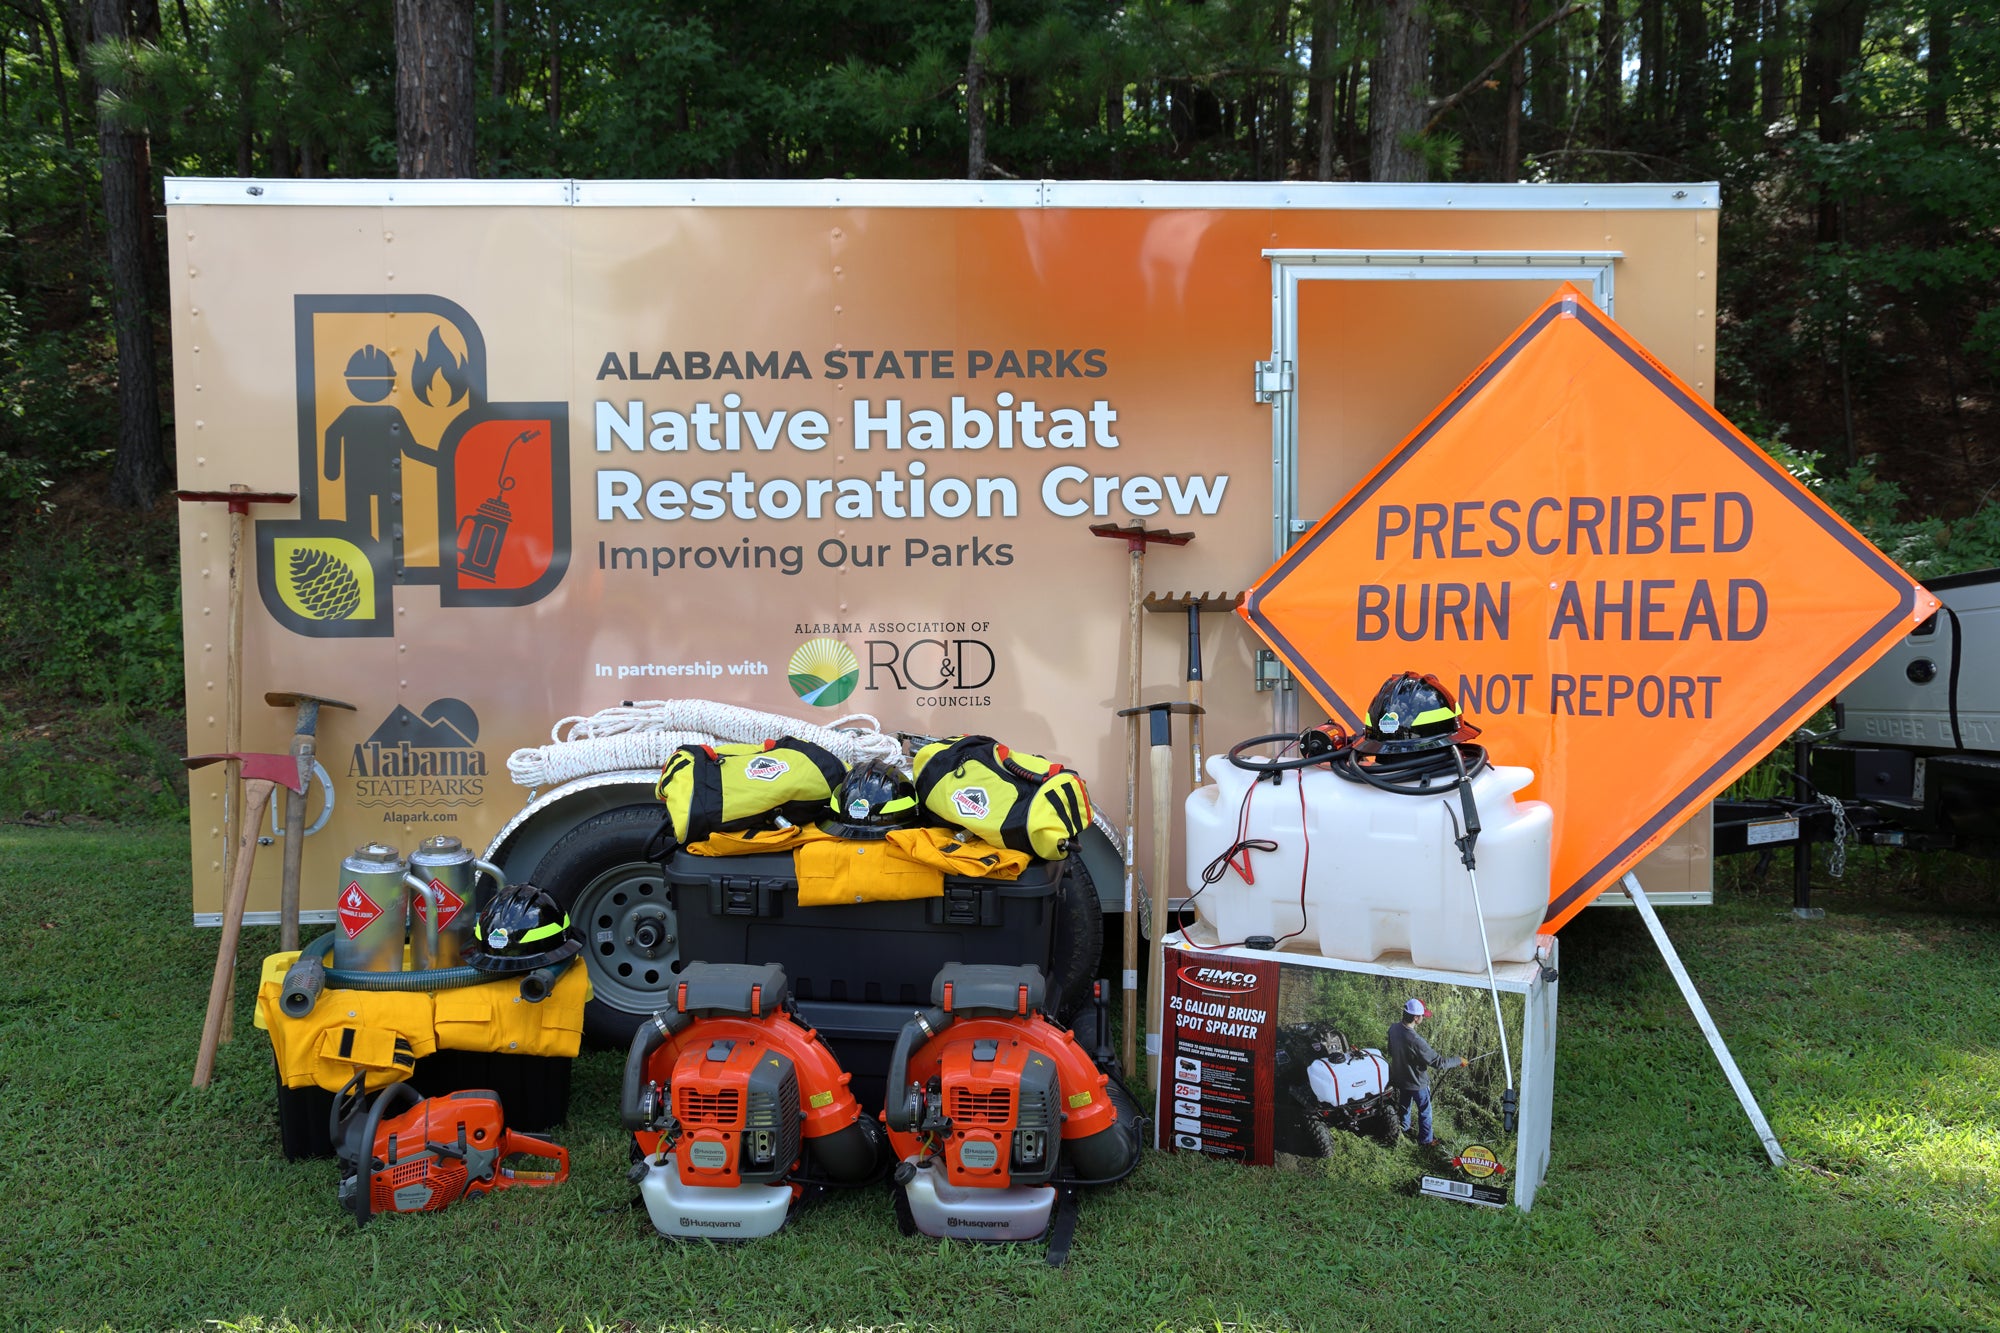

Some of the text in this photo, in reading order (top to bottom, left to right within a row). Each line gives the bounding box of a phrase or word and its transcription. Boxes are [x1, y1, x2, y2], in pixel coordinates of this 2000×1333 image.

[595, 348, 1108, 381] ALABAMA STATE PARKS
[595, 391, 1120, 452] Native Habitat
[596, 461, 1229, 521] Restoration Crew
[1375, 491, 1754, 561] PRESCRIBED
[597, 536, 1014, 576] Improving Our Parks
[1355, 579, 1768, 642] BURN AHEAD
[794, 621, 990, 635] ALABAMA ASSOCIATION OF
[595, 660, 768, 680] In partnership with
[864, 639, 996, 691] RC&D
[916, 695, 991, 707] COUNCILS
[1457, 673, 1722, 719] NOT REPORT
[1865, 717, 1926, 740] SUPER
[347, 743, 489, 777] Alabama
[356, 778, 484, 797] STATE PARKS
[383, 811, 458, 824] Alapark.com
[1195, 977, 1254, 988] INDUSTRIES
[1197, 968, 1257, 984] FIMCO
[1170, 995, 1267, 1024] 25 GALLON BRUSH
[1176, 1014, 1258, 1040] SPOT SPRAYER
[1176, 1085, 1189, 1096] 25
[1461, 1157, 1498, 1169] WARRANTY
[690, 1219, 742, 1229] Husqvarna
[958, 1219, 1010, 1229] Husqvarna
